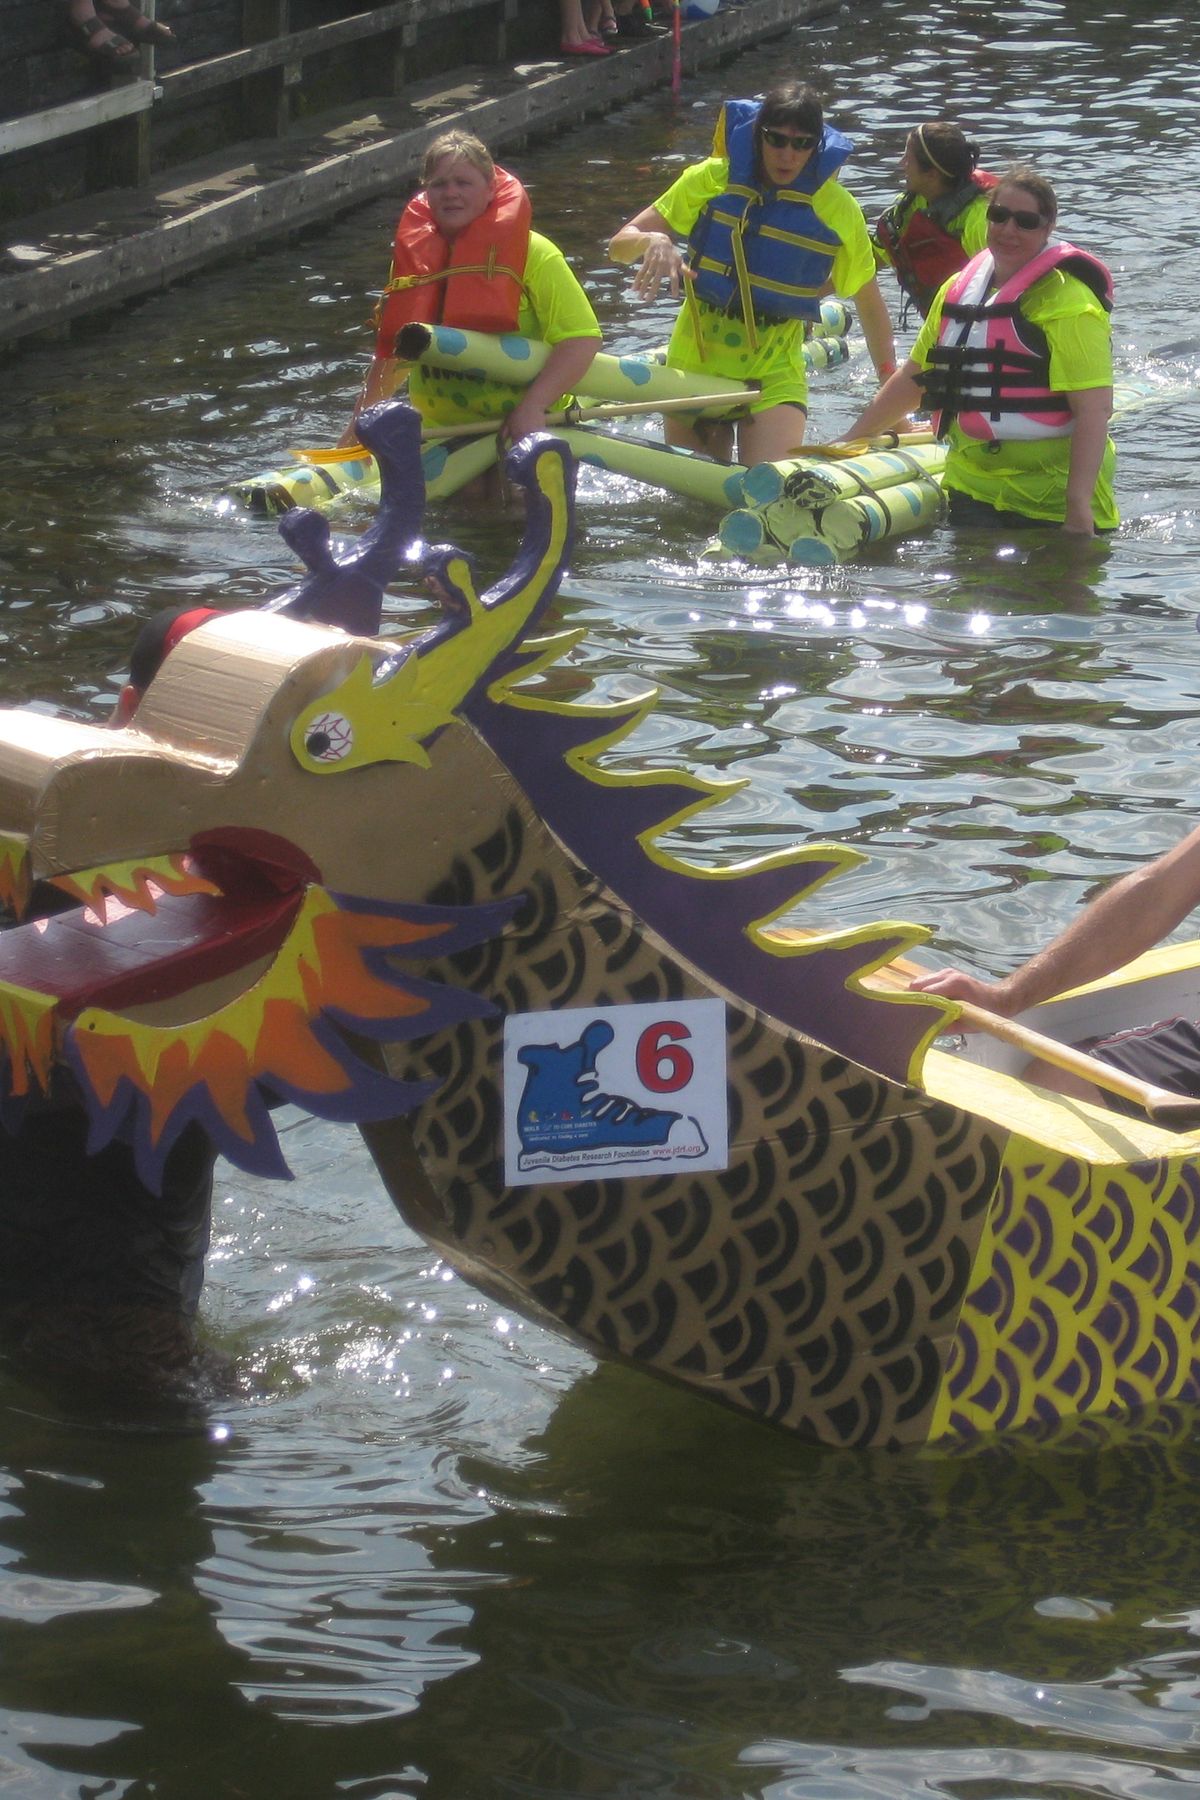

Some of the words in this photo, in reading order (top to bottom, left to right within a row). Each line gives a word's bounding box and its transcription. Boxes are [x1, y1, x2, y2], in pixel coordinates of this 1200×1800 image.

[635, 1020, 694, 1093] 6
[522, 1155, 550, 1165] Juvenile
[552, 1152, 580, 1164] Diabetes
[582, 1150, 612, 1161] Research
[613, 1148, 650, 1159] Foundation
[652, 1144, 701, 1156] www.jdrf.org
